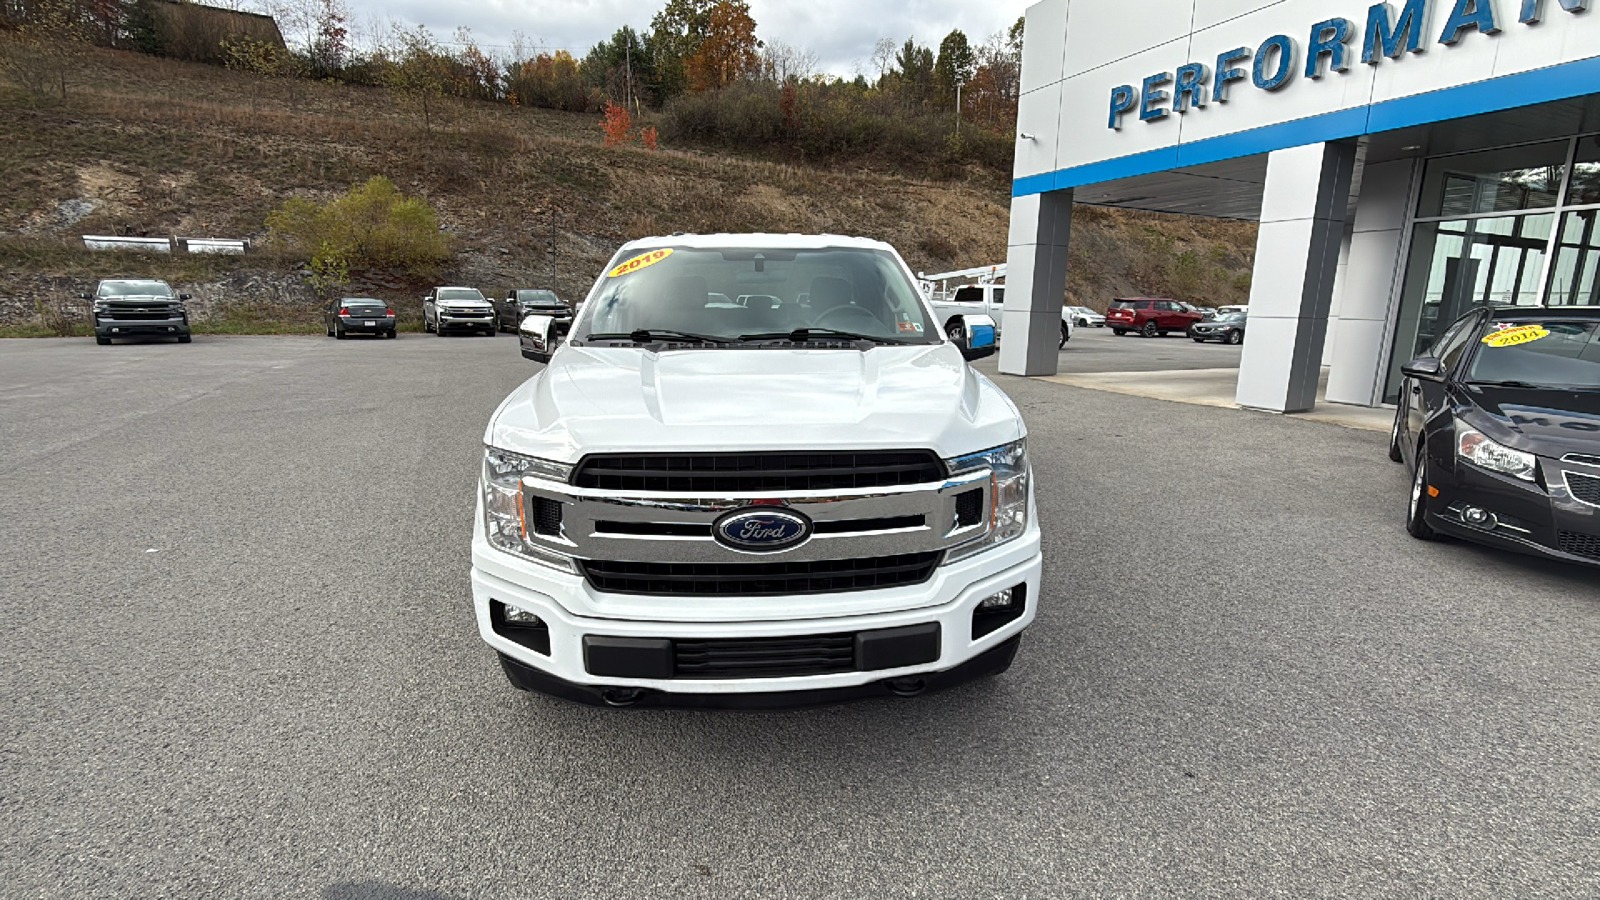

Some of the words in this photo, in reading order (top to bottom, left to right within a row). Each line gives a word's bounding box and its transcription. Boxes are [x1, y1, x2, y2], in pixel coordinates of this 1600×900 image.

[616, 250, 665, 275] 2019
[1499, 330, 1540, 345] 2014
[740, 519, 786, 539] Ford
